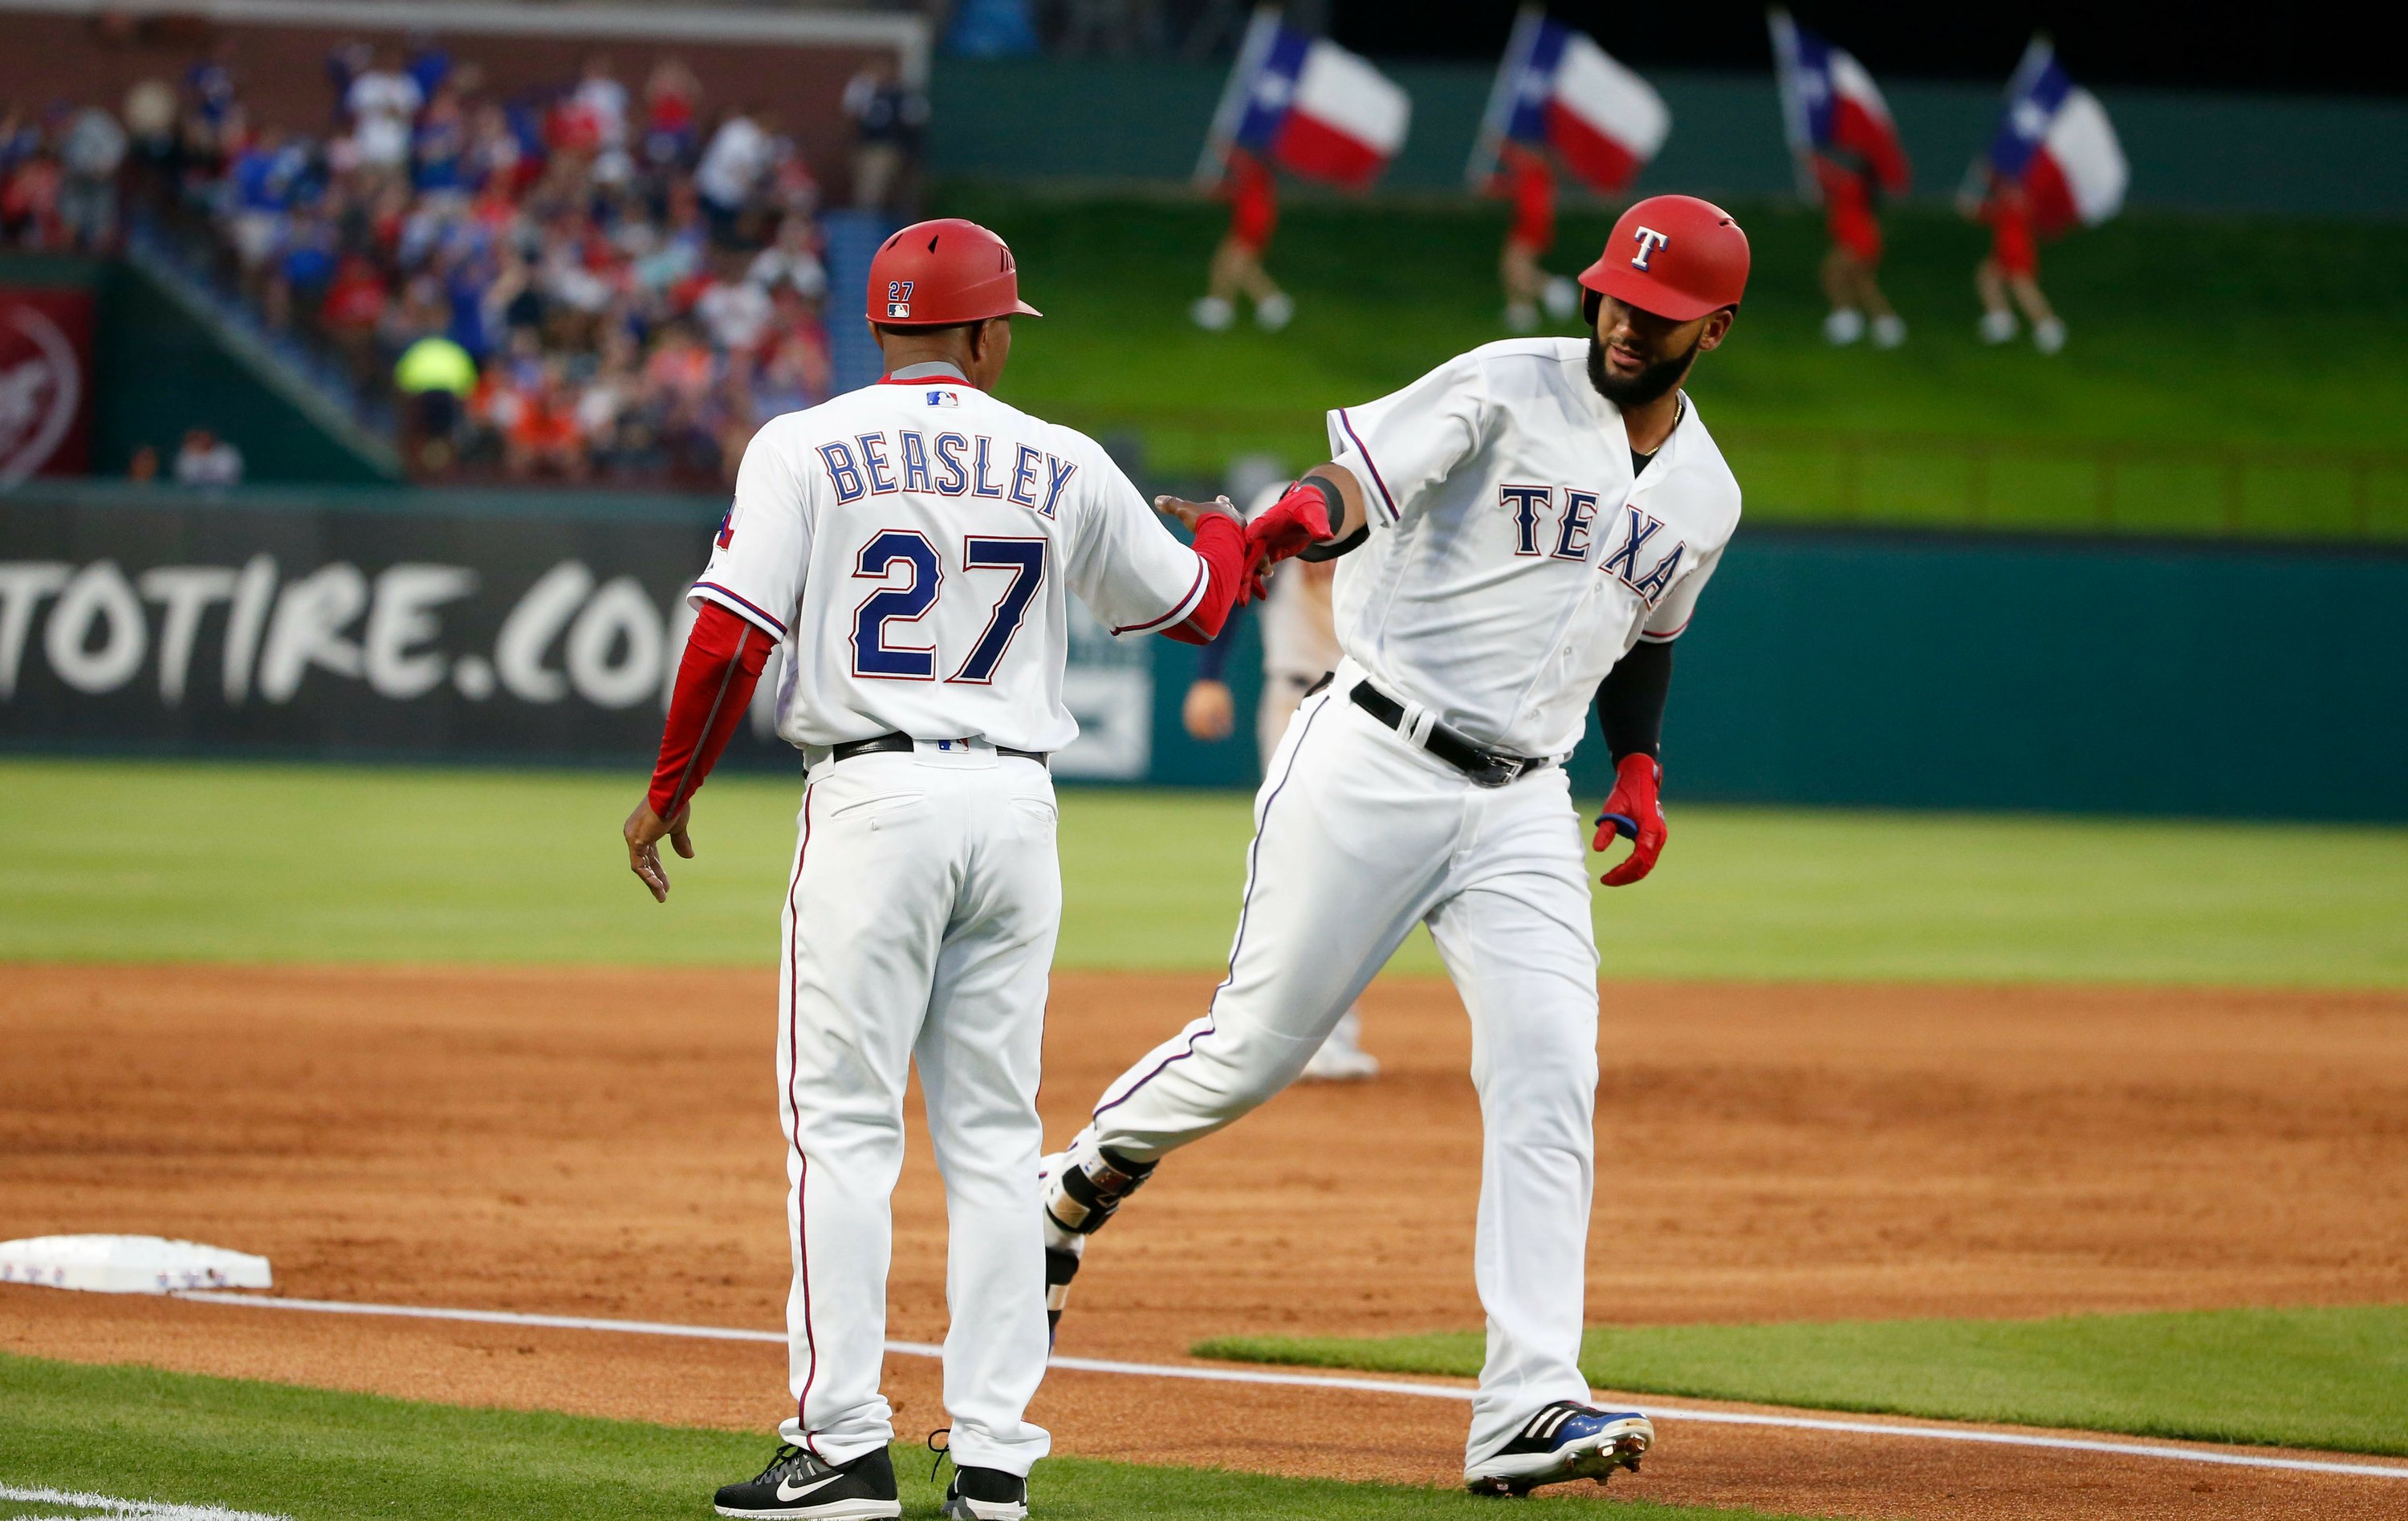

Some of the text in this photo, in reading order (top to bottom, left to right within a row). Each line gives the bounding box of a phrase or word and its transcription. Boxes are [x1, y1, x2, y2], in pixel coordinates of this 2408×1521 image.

[888, 281, 914, 302] 27
[1631, 226, 1670, 271] T
[815, 430, 1077, 520] BEASLEY
[1499, 484, 1690, 612] TEXA
[848, 529, 1048, 685] 27
